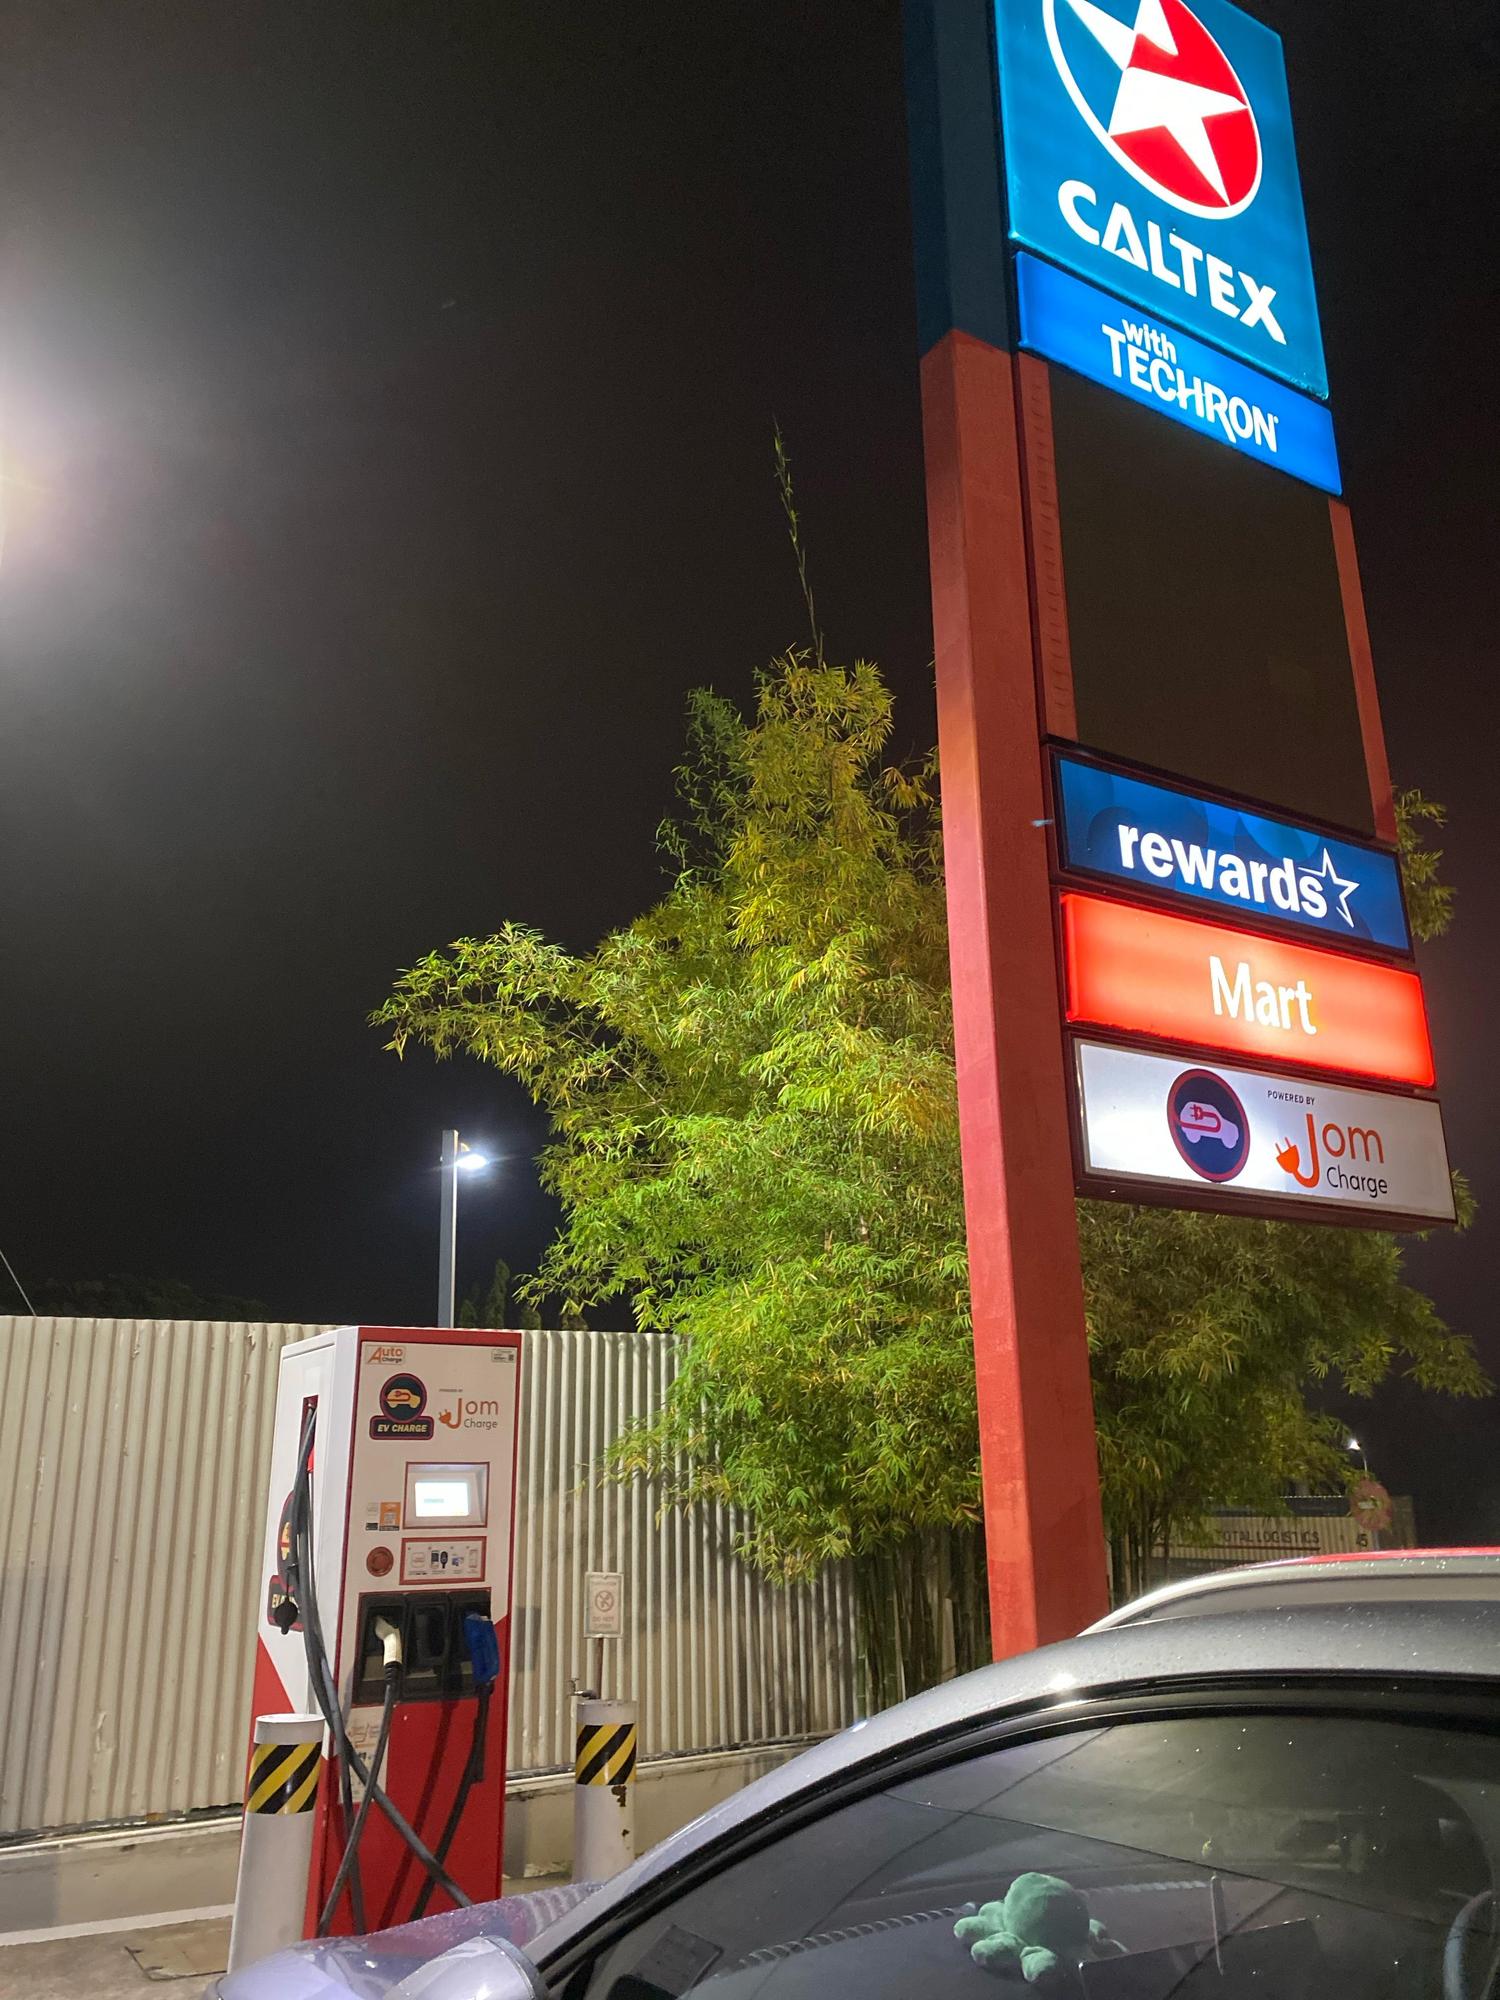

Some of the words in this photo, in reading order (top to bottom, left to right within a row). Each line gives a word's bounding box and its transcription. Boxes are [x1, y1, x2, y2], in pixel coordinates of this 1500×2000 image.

[1057, 179, 1287, 345] CALTEX
[1121, 318, 1177, 365] with
[1101, 323, 1278, 452] TECHRON
[1118, 823, 1328, 918] rewards
[1209, 955, 1317, 1036] Mart
[1267, 1090, 1304, 1104] POWERED
[1306, 1096, 1315, 1105] BY
[1275, 1113, 1385, 1188] Jom
[1326, 1164, 1388, 1198] Charge
[367, 1346, 403, 1364] Auto
[377, 1424, 389, 1432] EV
[391, 1424, 428, 1432] CHARGE
[438, 1398, 499, 1429] Jom
[463, 1418, 498, 1430] Charge
[1257, 1531, 1320, 1544] LOGISTICS
